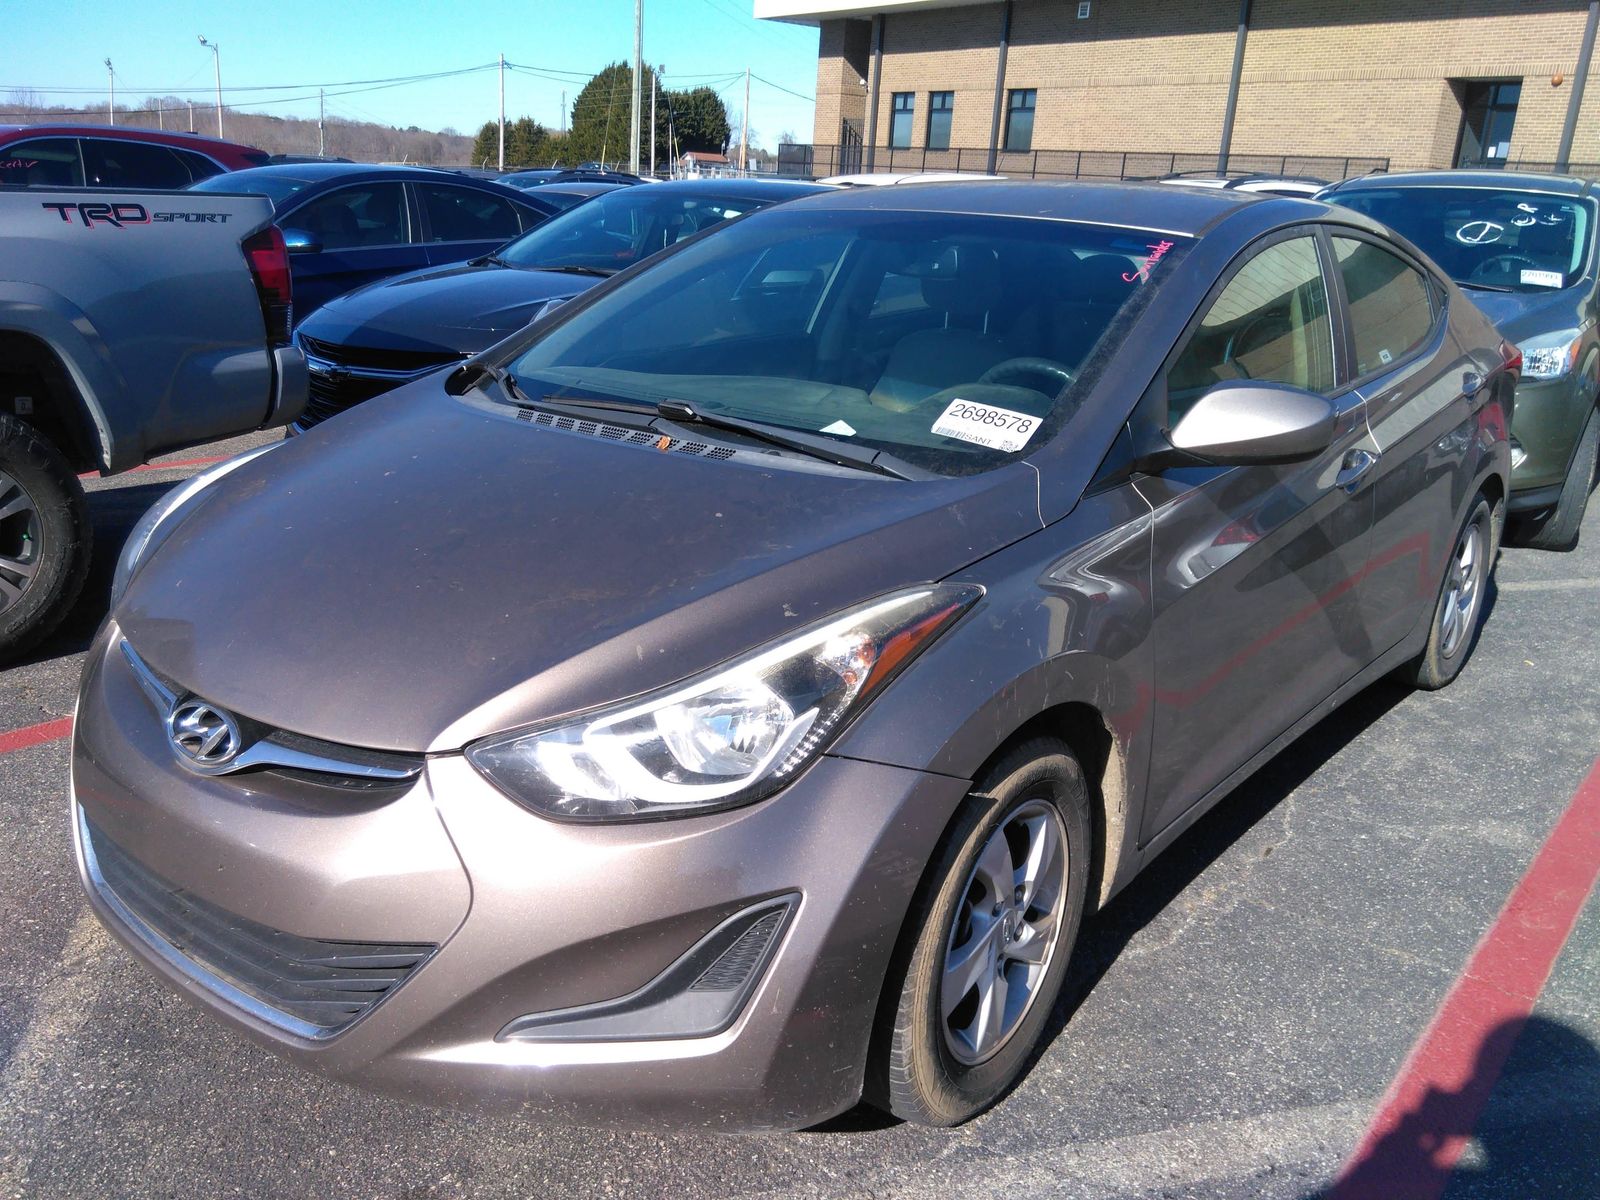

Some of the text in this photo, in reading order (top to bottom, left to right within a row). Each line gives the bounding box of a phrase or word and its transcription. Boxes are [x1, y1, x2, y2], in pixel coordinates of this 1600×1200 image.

[42, 202, 232, 230] TRD SPORT
[949, 403, 1033, 434] 2698578
[964, 433, 992, 446] SANT
